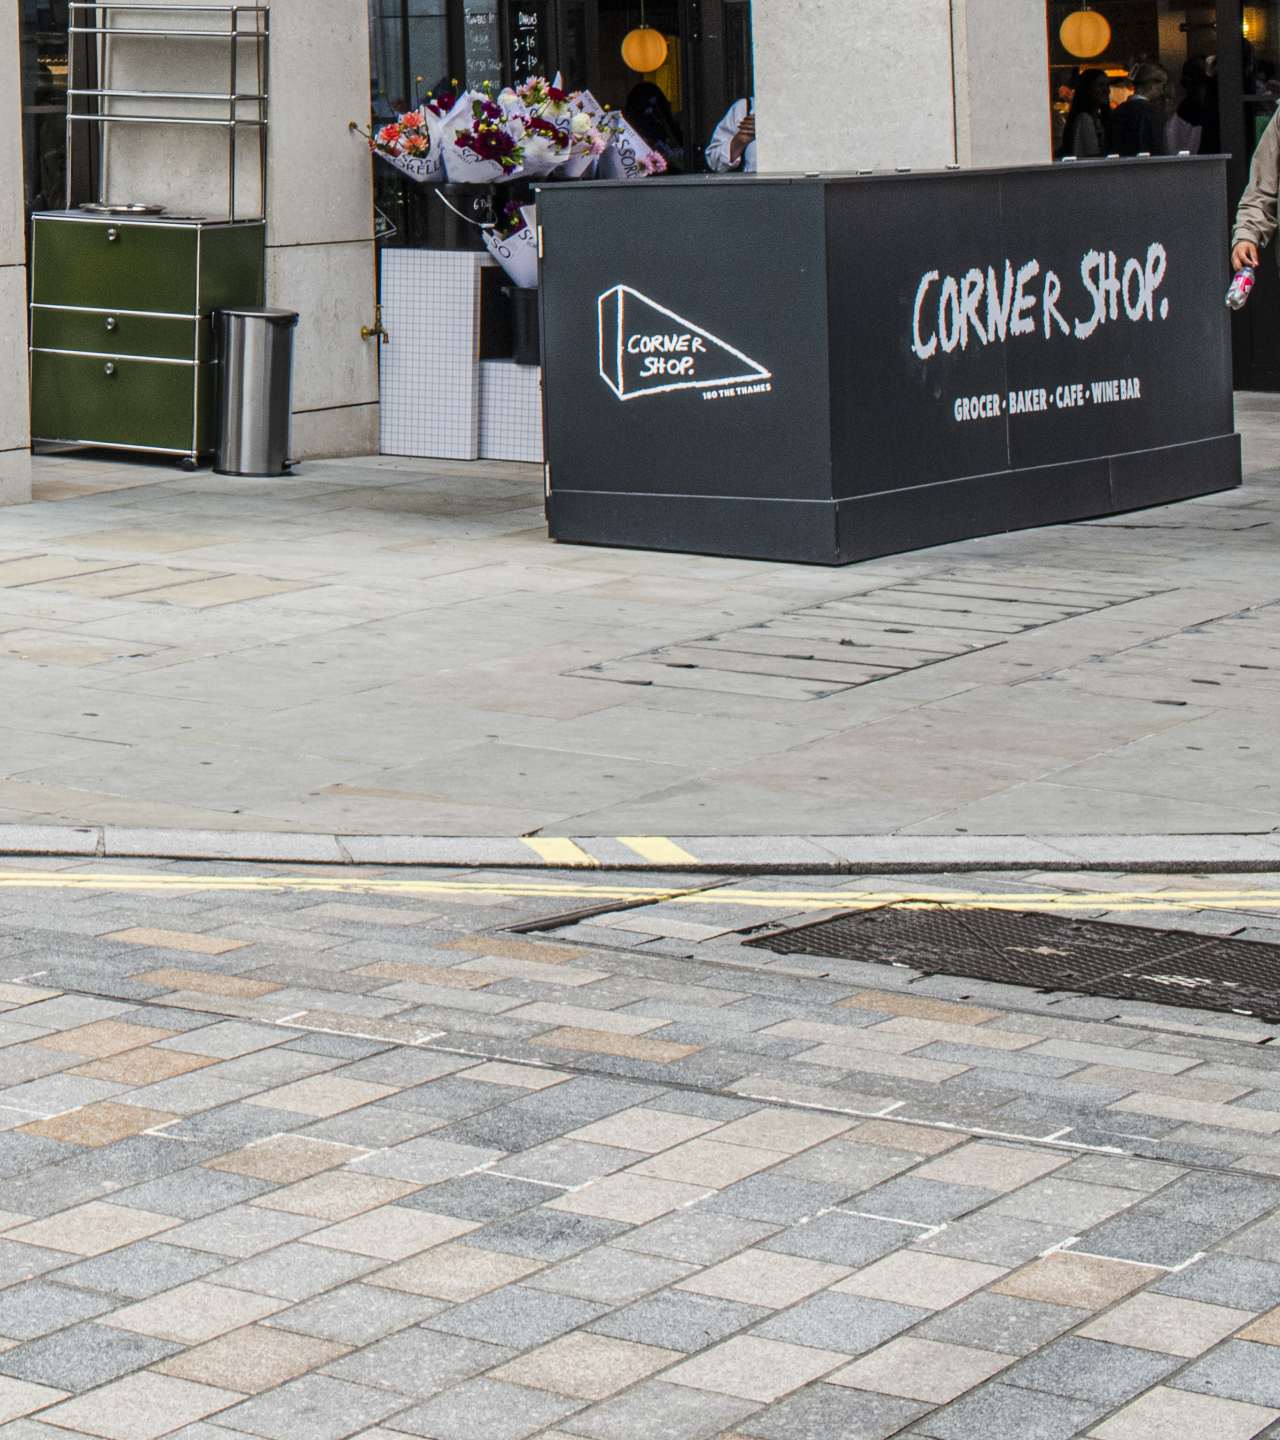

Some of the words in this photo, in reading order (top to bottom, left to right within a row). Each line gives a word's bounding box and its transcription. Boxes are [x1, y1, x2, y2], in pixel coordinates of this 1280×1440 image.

[911, 259, 1070, 360] CORNER
[1074, 242, 1169, 339] SHOP.
[627, 334, 706, 353] CORNER
[639, 356, 695, 378] SHOP.
[718, 387, 735, 398] THE
[735, 382, 773, 396] THAMES
[954, 393, 1001, 422] GROCER
[1008, 388, 1048, 415] BAKER
[1055, 384, 1084, 409] CAFE
[1091, 379, 1119, 404] WINE
[1119, 377, 1141, 400] BAR
